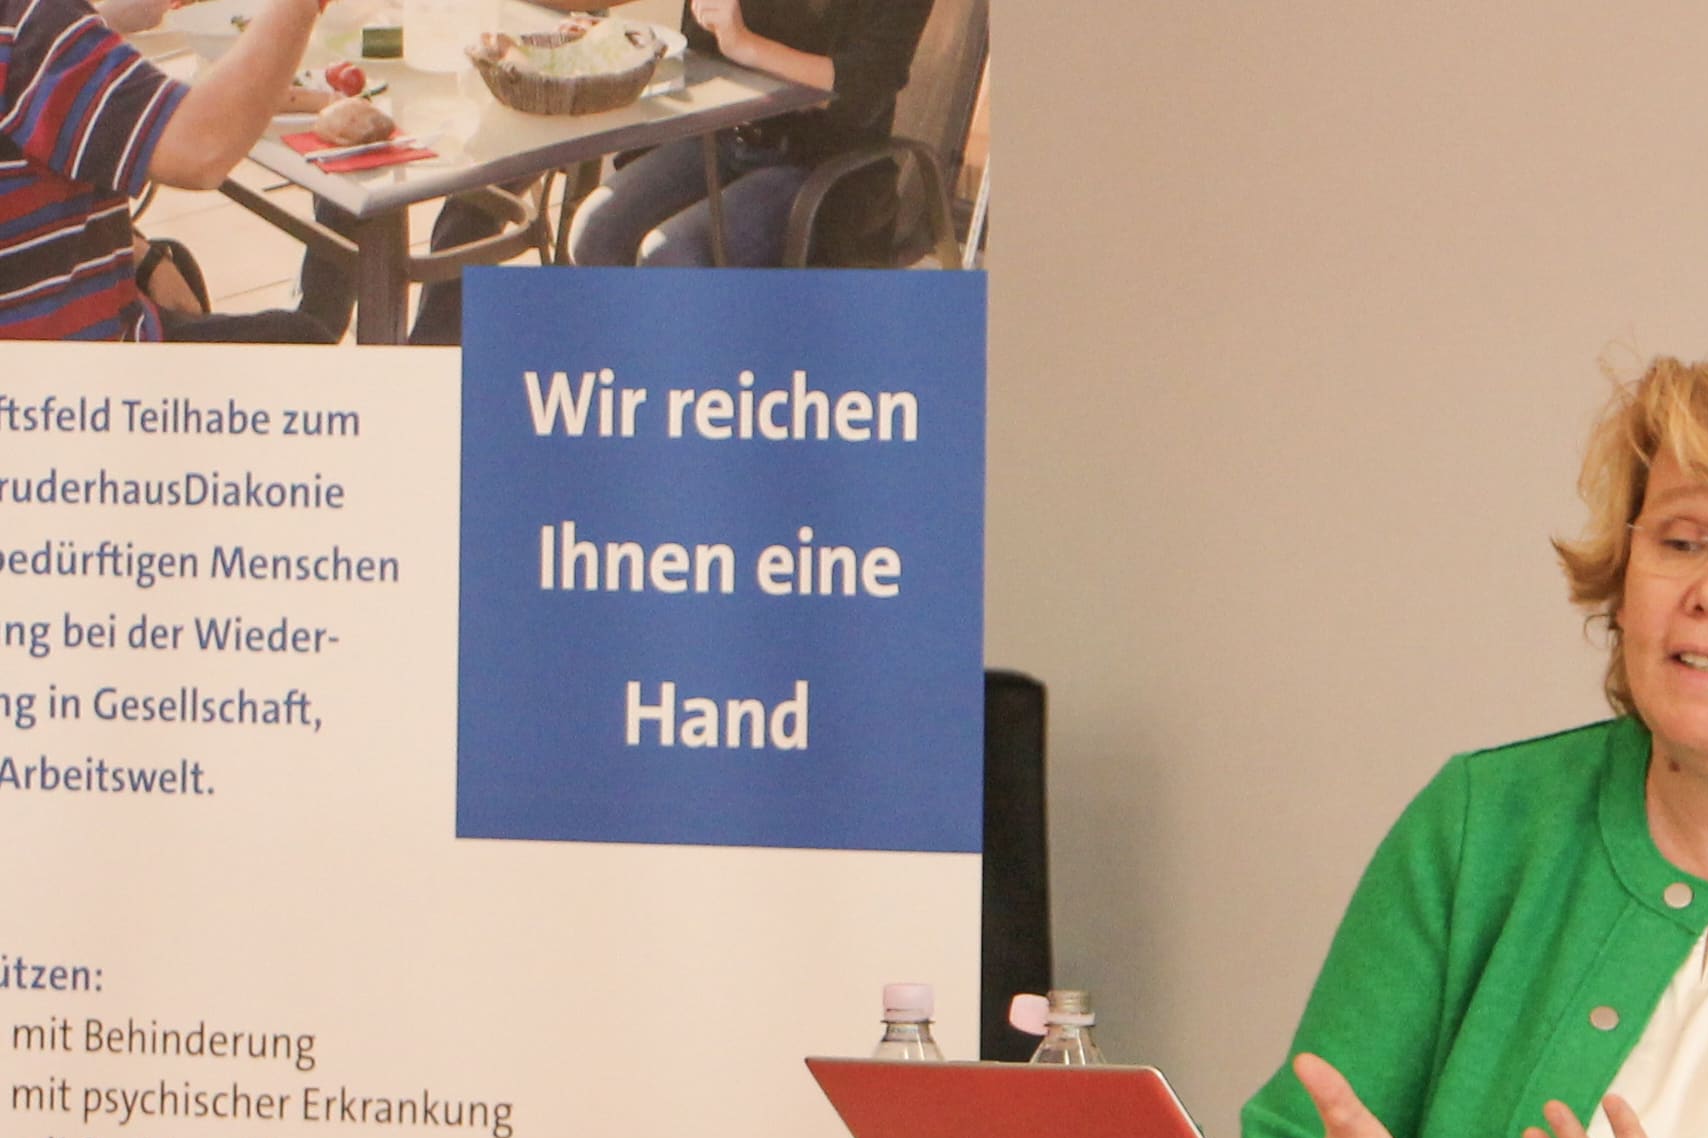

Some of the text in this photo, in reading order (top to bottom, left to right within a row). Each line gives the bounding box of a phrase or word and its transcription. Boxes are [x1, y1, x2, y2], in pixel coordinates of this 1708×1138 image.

[121, 398, 271, 436] Teilhabe
[282, 409, 361, 437] zum
[523, 368, 919, 443] Wir reichen
[0, 540, 400, 589] edürftigen Menschen
[541, 520, 902, 598] Ihnen eine
[63, 612, 116, 649] bei
[127, 613, 184, 650] der
[194, 616, 340, 653] Wieder-
[49, 684, 81, 719] in
[93, 686, 323, 732] Gesellschaft,
[625, 680, 808, 751] Hand
[0, 755, 215, 795] Arbeitswelt.
[13, 1016, 317, 1071] mit Behinderung
[12, 1076, 71, 1112] mit
[83, 1079, 291, 1126] psychischer
